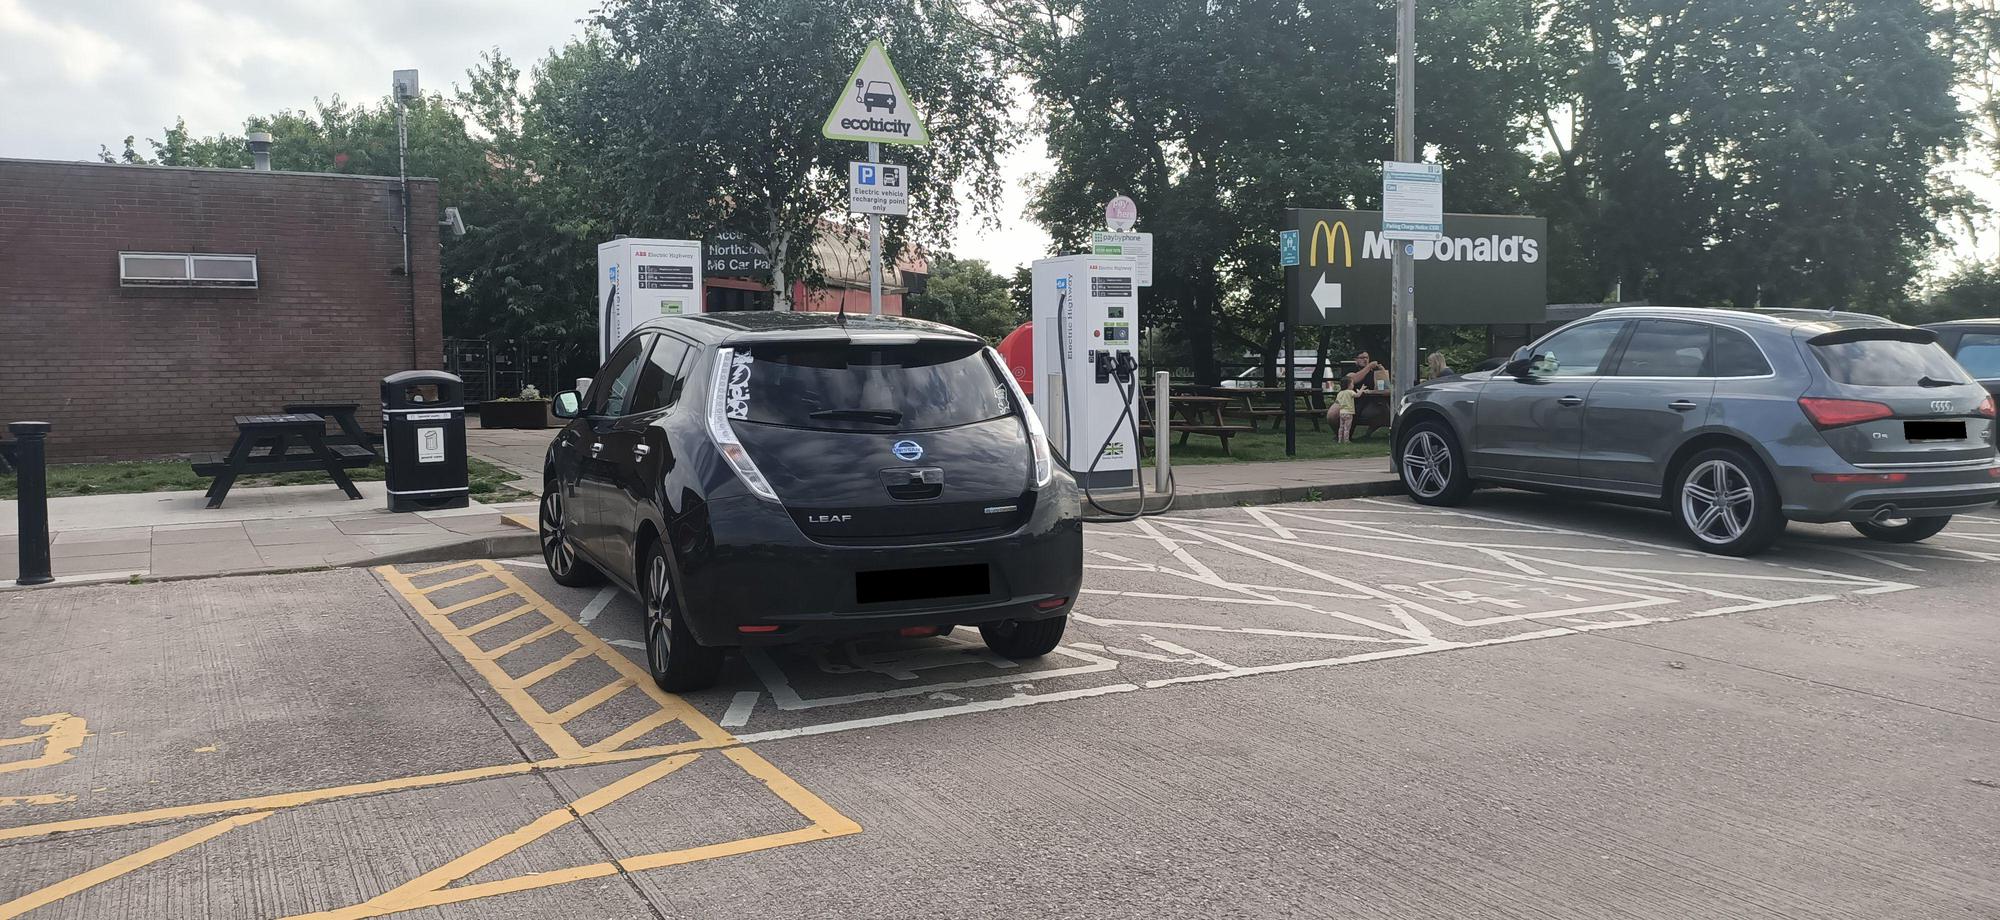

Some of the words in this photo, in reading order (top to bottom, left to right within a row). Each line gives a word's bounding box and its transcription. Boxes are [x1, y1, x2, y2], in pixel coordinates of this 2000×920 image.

[841, 117, 911, 137] ecotricity
[862, 167, 873, 183] P
[854, 187, 879, 196] Electric
[853, 196, 887, 205] recharging
[872, 204, 886, 212] only
[1103, 234, 1141, 242] paybyphone
[1362, 230, 1538, 263] MDonald's
[670, 252, 693, 260] Highway
[707, 259, 725, 270] M6
[729, 259, 750, 271] Car
[808, 515, 852, 523] LEAF
